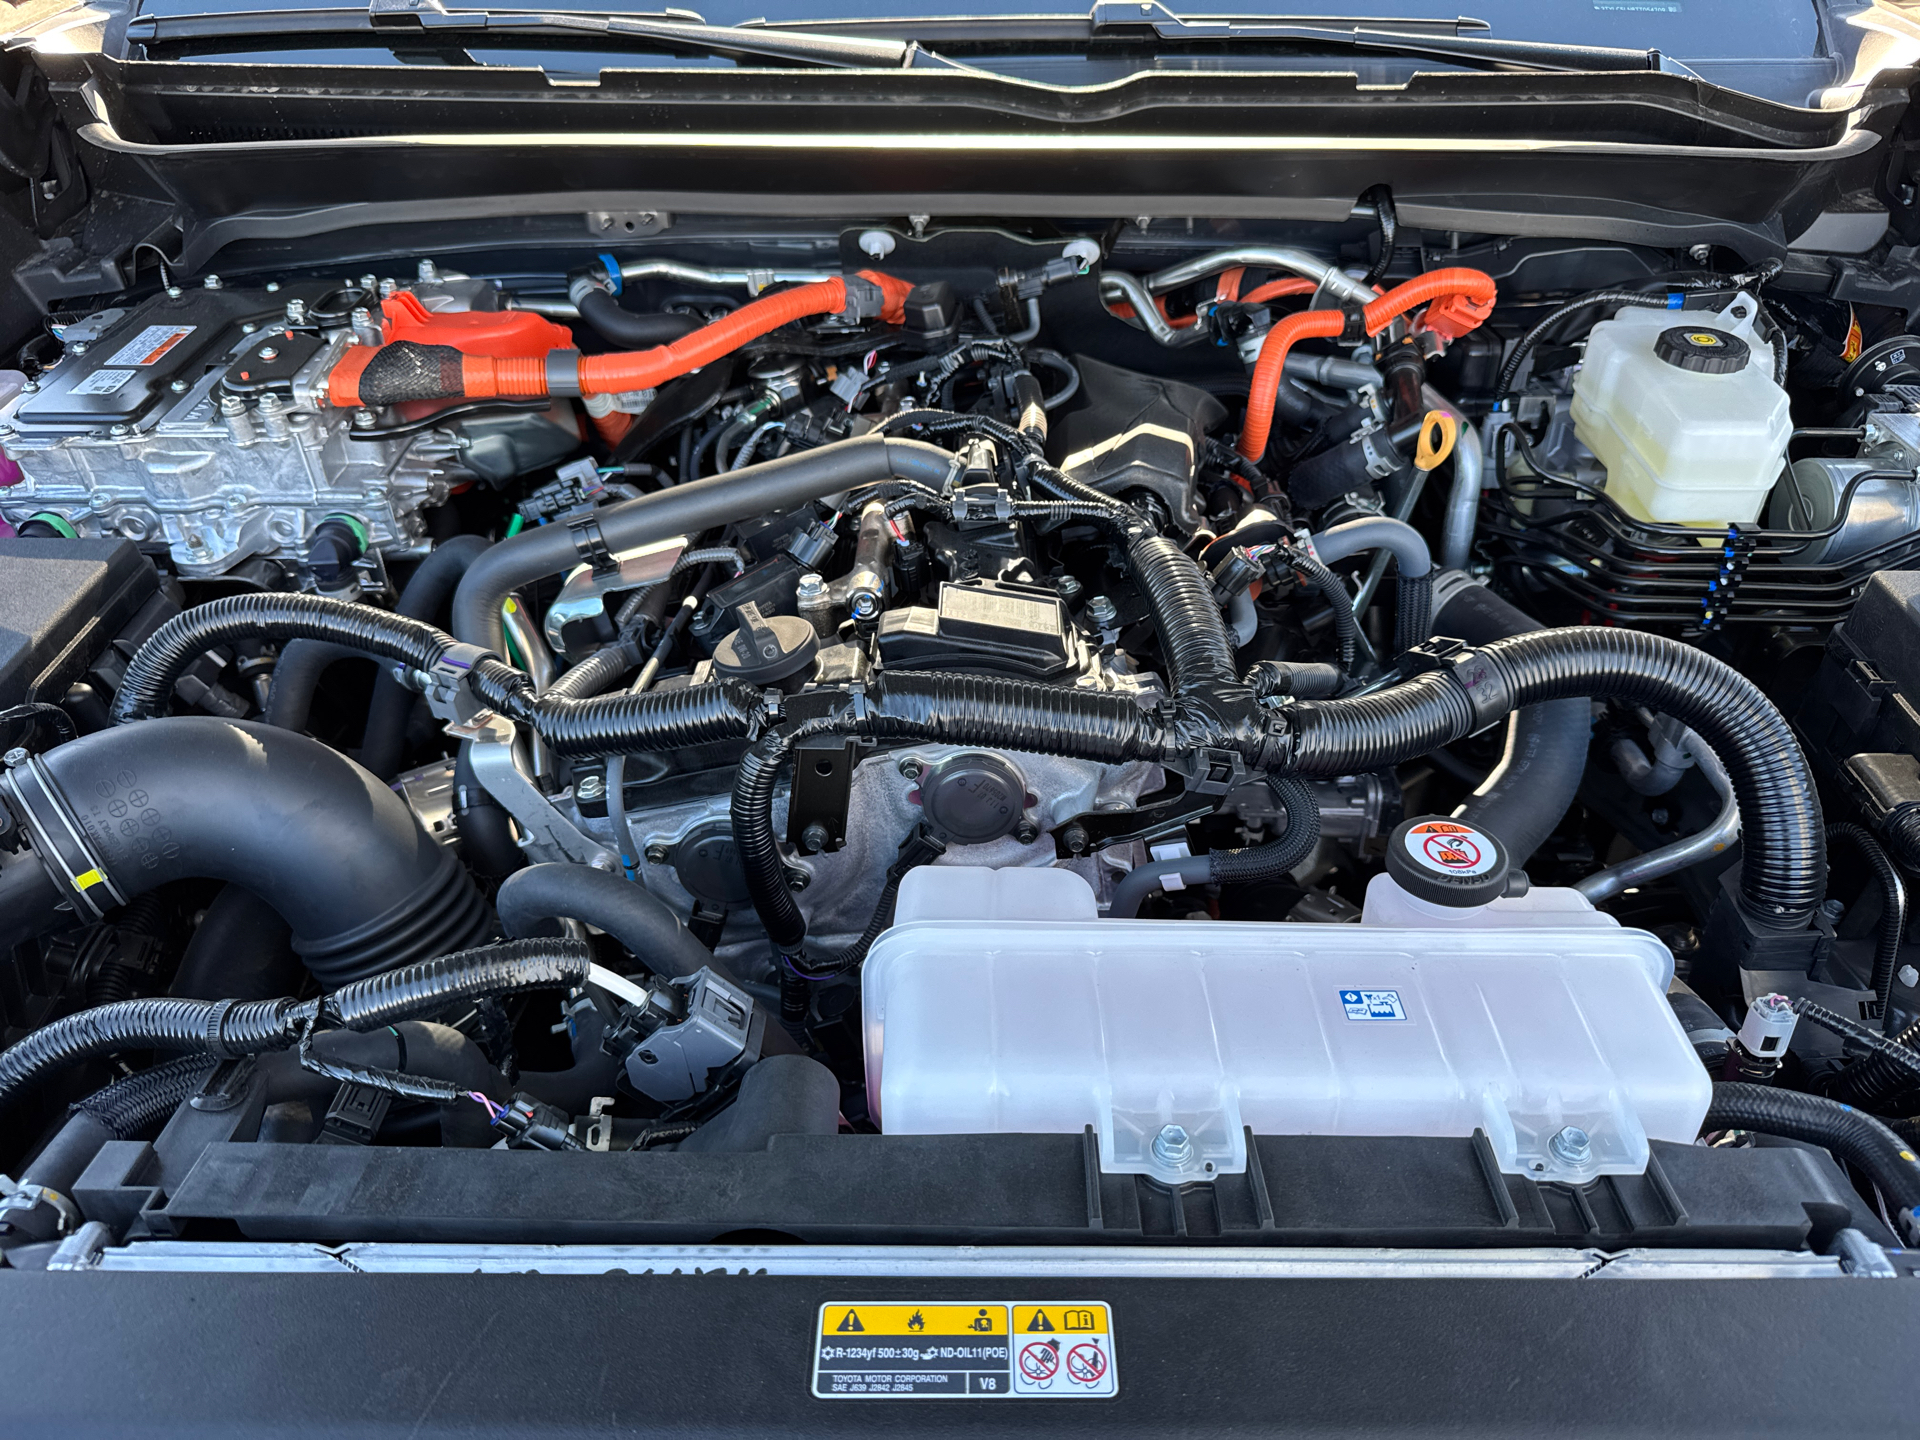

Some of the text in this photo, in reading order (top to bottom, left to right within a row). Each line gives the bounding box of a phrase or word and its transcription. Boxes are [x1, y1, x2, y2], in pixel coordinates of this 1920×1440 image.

[1476, 681, 1496, 703] 32
[1437, 873, 1491, 887] DENSO
[835, 1346, 1008, 1361] R-1234yf 500±30g ND-OIL11(POE)
[832, 1375, 948, 1383] TOYOTA MOTOR CORPORATION
[980, 1377, 997, 1390] V8
[832, 1383, 914, 1392] SAE J639 J2842 J2845
